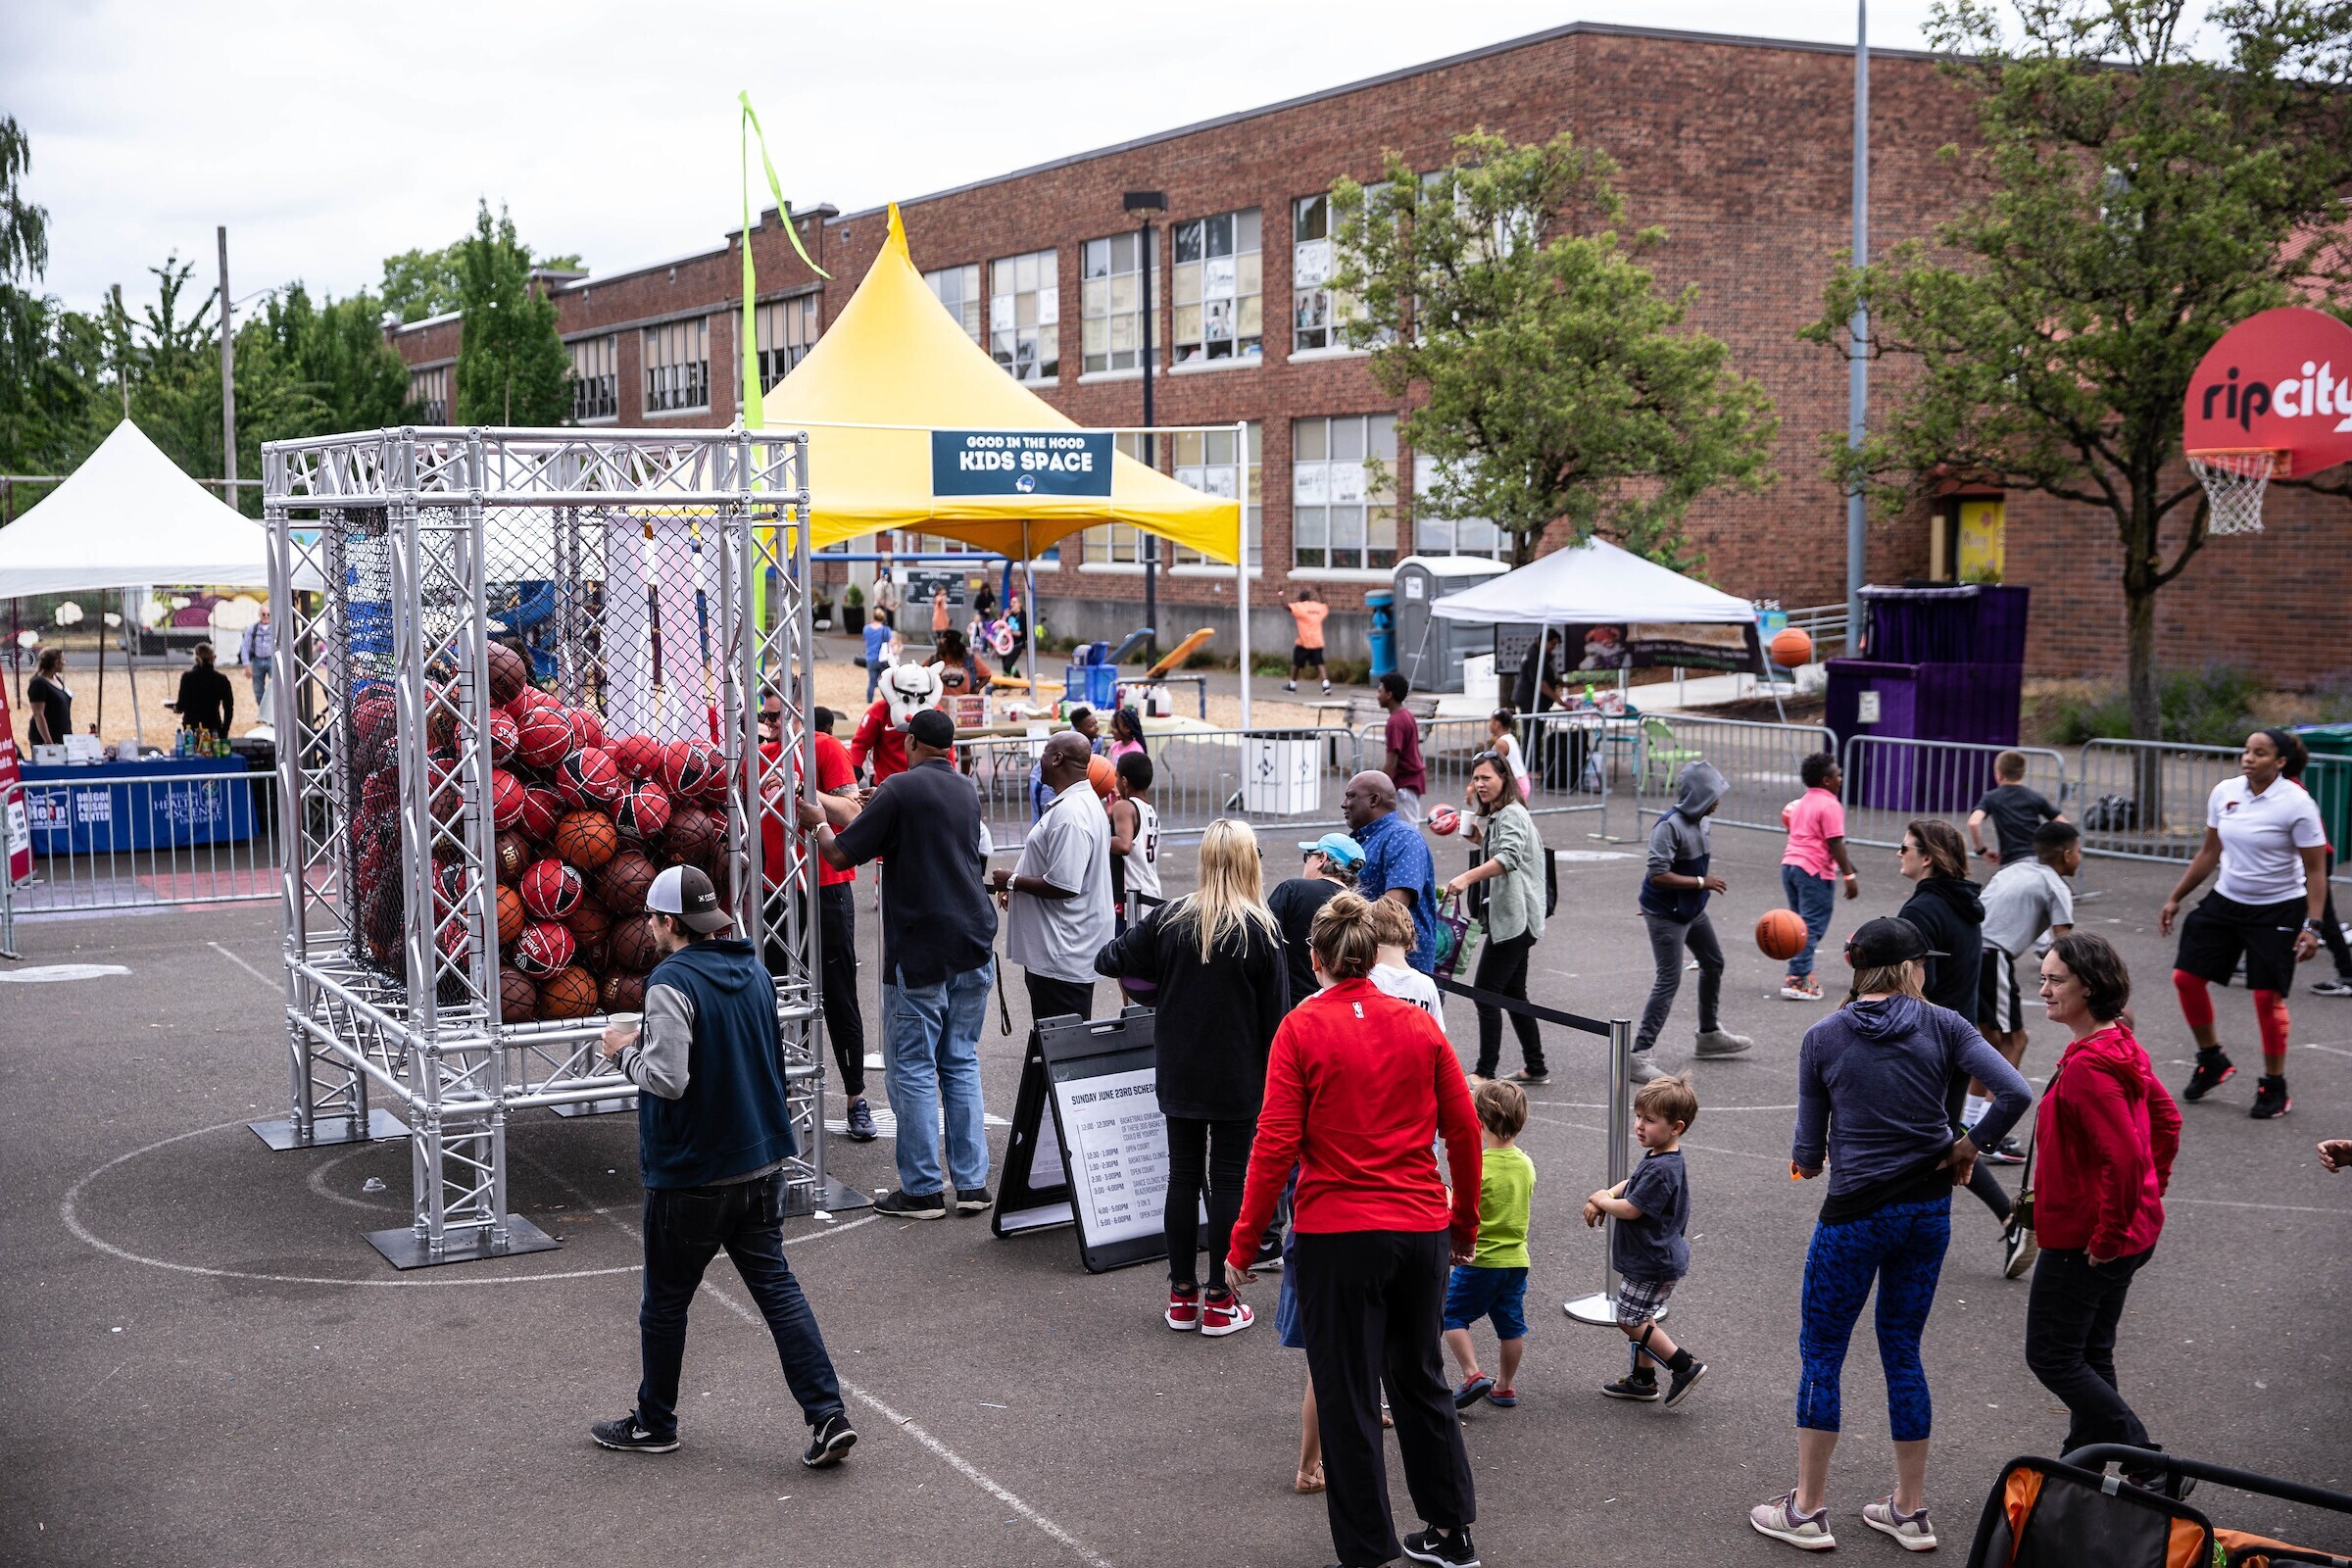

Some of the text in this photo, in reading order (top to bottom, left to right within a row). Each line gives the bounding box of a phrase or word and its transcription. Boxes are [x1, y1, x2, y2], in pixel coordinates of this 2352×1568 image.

[966, 436, 1085, 449] GOOD IN THE HOOD
[959, 451, 1093, 471] KIDS SPACE
[1071, 1092, 1097, 1105] SUNDAY
[1099, 1090, 1114, 1102] JUNE
[1114, 1087, 1132, 1098] 23RD
[1119, 1113, 1143, 1125] BASKETBALL
[1102, 1148, 1118, 1156] 1:30PM
[1102, 1159, 1118, 1169] 2:30PM
[1127, 1153, 1152, 1164] BASKETBALL
[1104, 1171, 1122, 1181] 3:00PM
[1142, 1165, 1154, 1174] COURT
[1106, 1183, 1125, 1193] 4:00PM
[1132, 1179, 1146, 1188] DANCE
[1110, 1202, 1129, 1212] 5:00PM
[1140, 1210, 1151, 1219] OPEN
[1151, 1208, 1163, 1217] COURT
